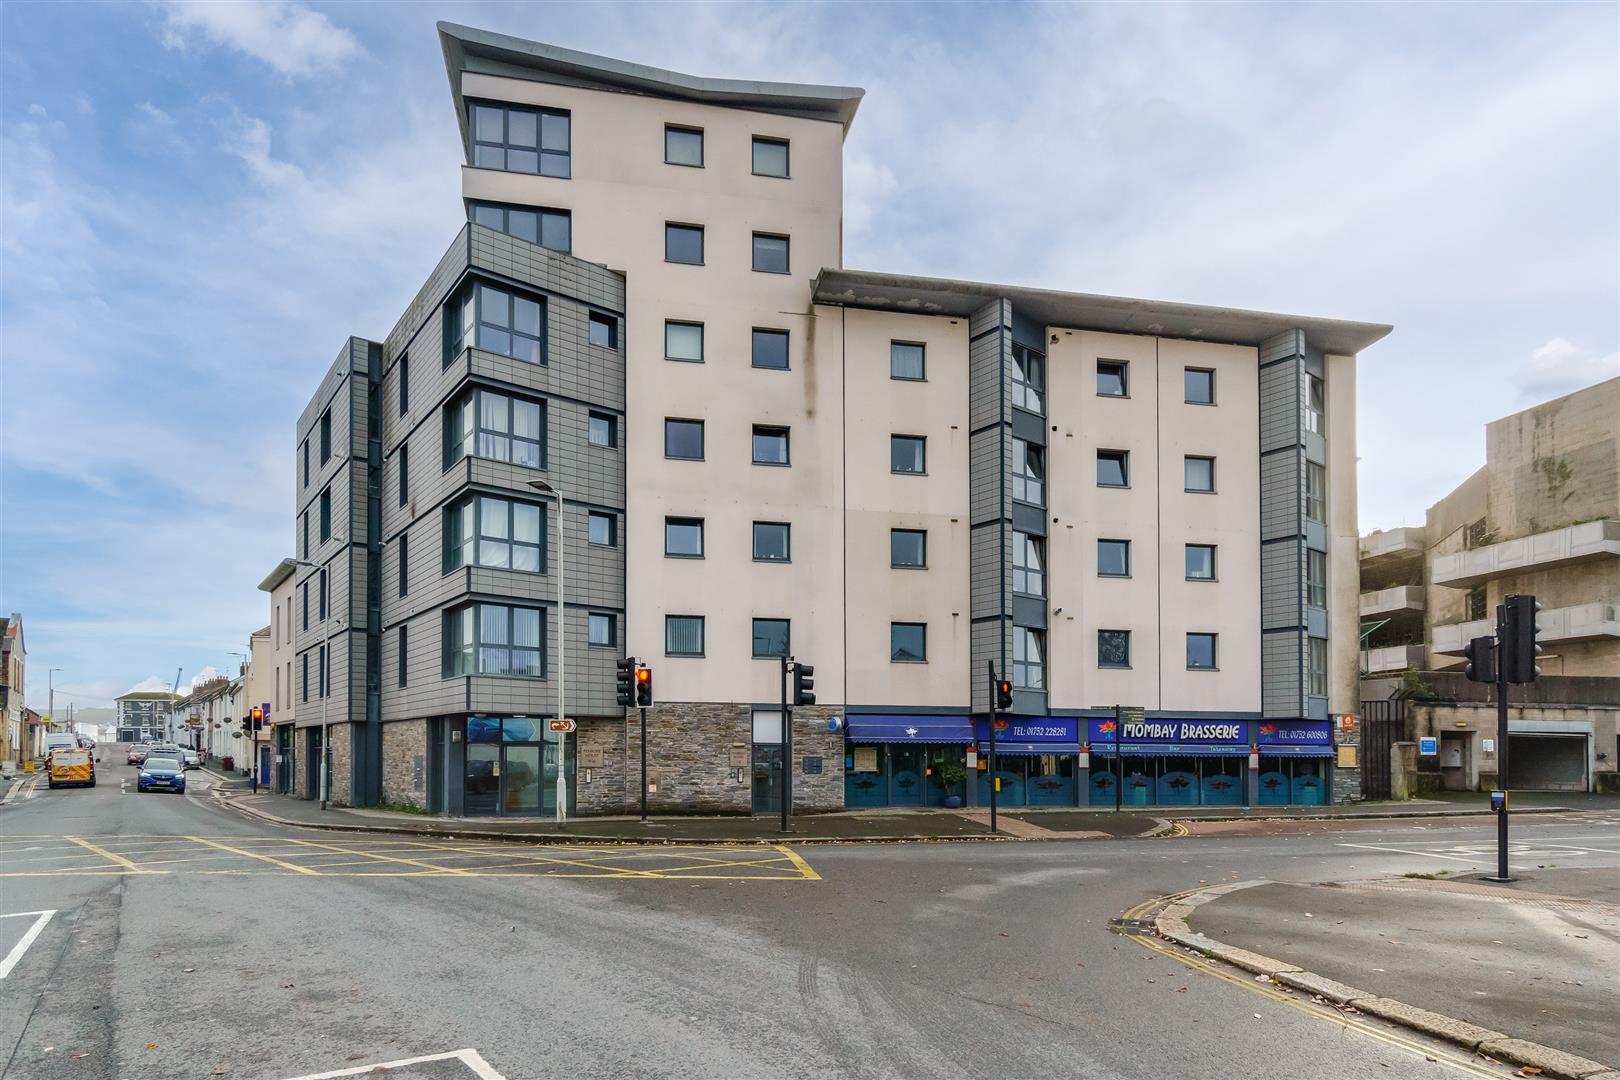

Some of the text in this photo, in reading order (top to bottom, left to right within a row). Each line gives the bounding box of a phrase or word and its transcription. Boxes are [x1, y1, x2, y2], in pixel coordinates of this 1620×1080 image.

[1013, 726, 1026, 736] TEL:
[1026, 727, 1044, 736] 01752
[1123, 723, 1240, 739] MOMBAY BRASSERIE
[1278, 730, 1290, 739] TEL:
